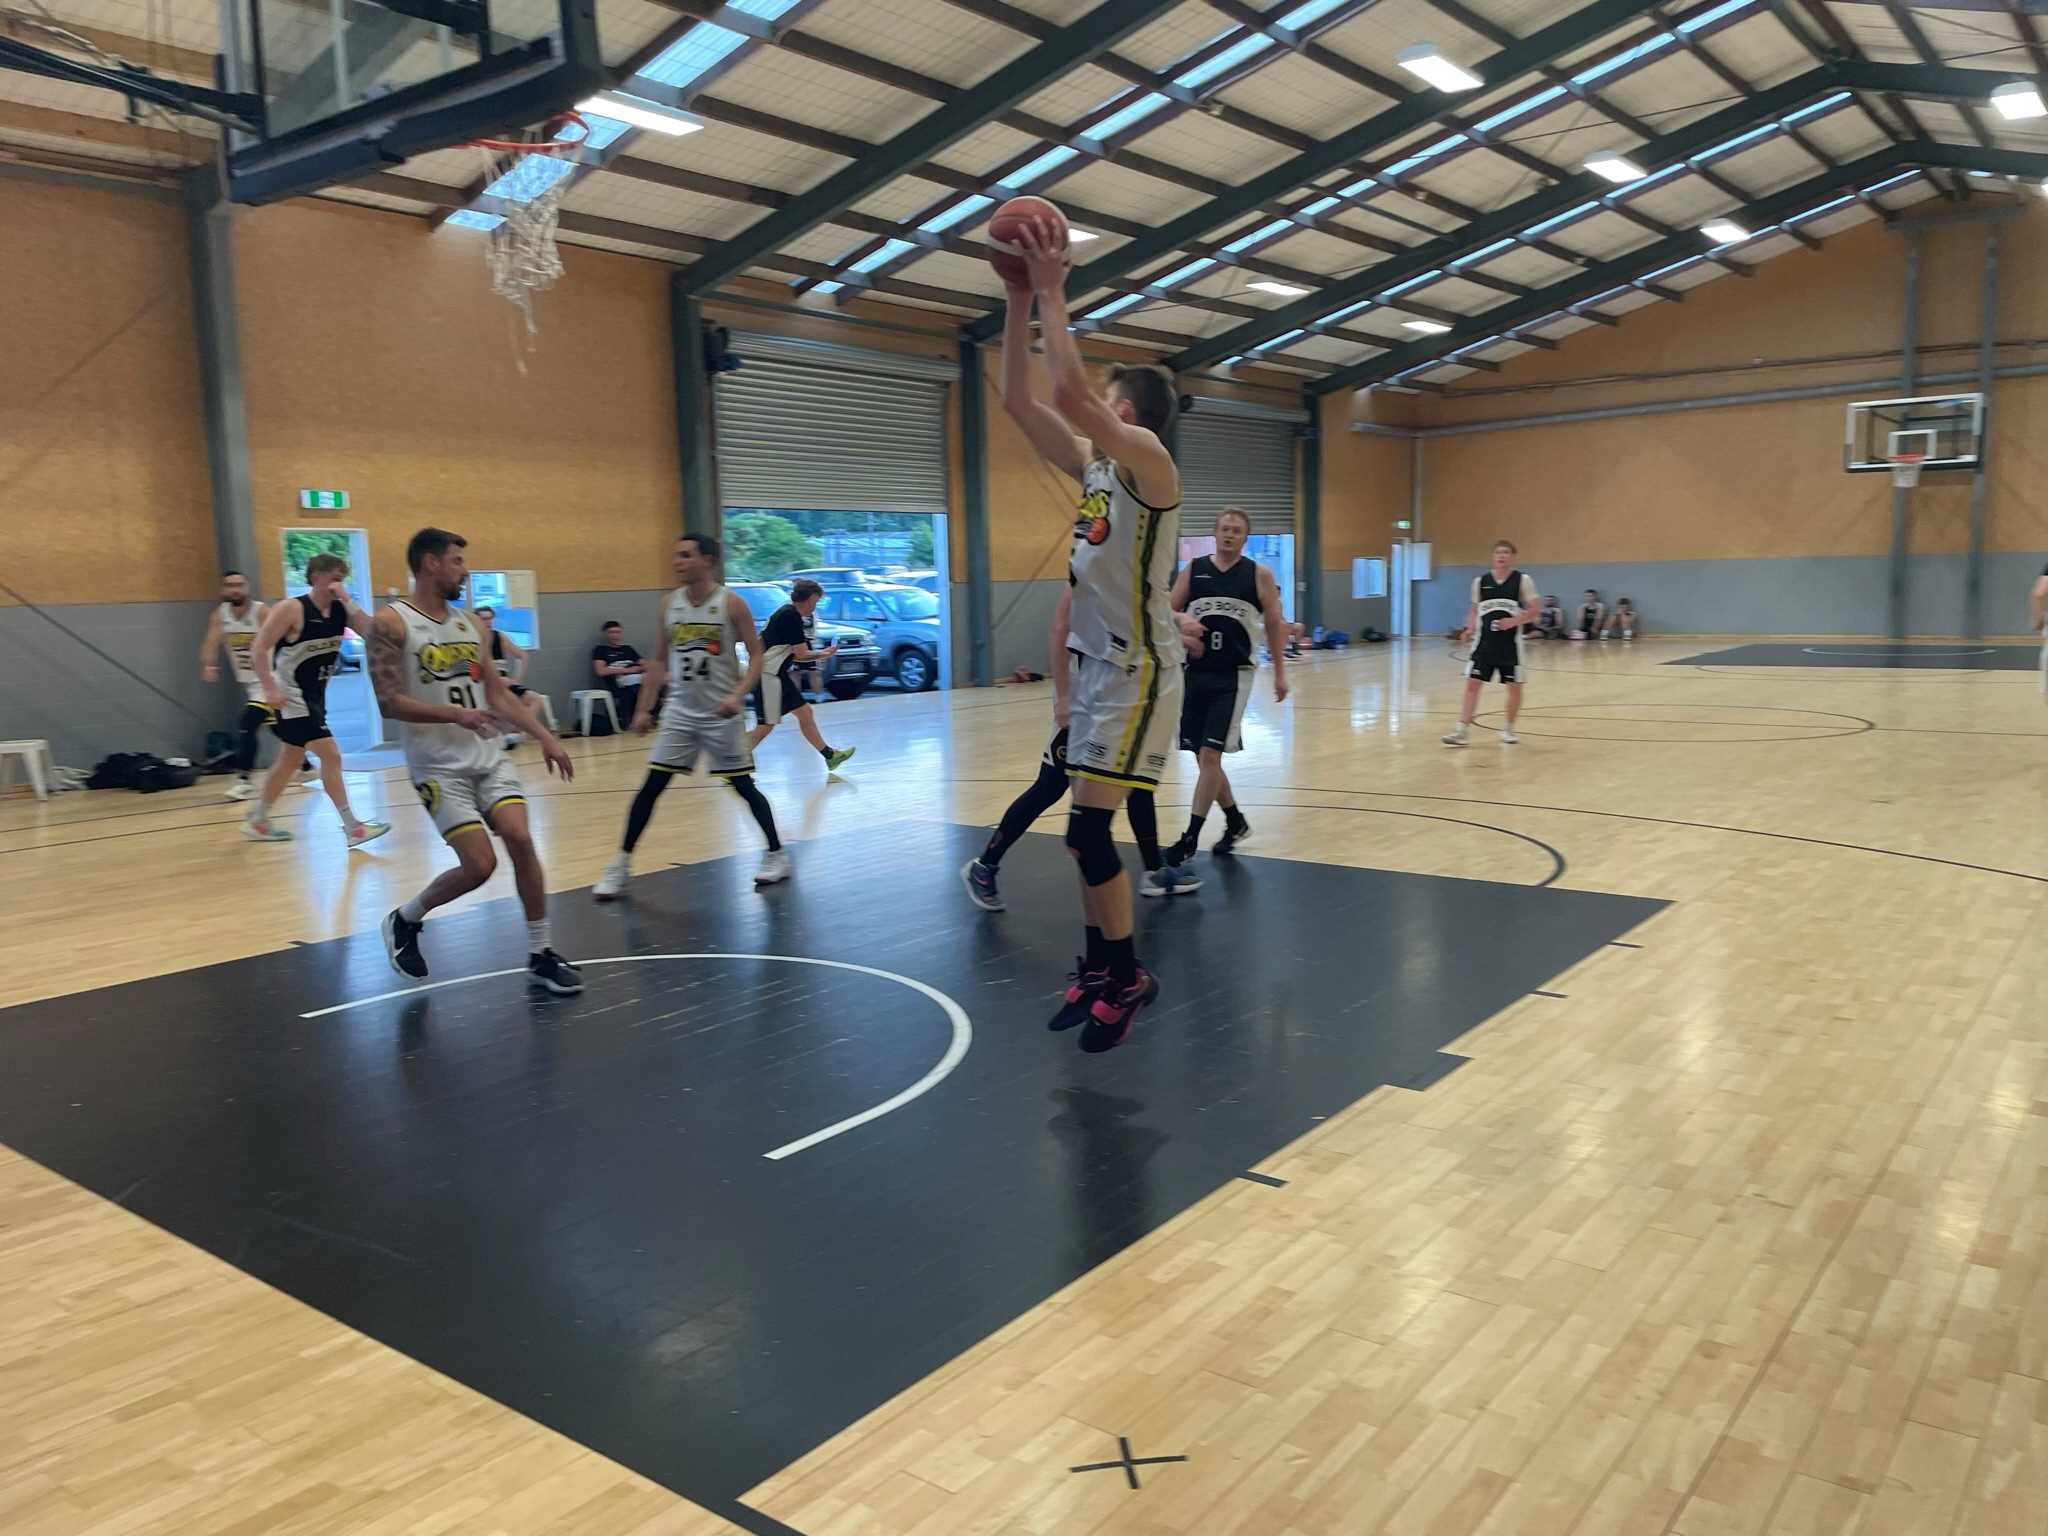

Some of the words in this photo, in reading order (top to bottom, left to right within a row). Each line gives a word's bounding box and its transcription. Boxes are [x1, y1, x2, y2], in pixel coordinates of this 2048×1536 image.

[1214, 601, 1248, 617] BOYS
[1211, 631, 1223, 650] 8
[682, 656, 711, 681] 24
[449, 685, 478, 708] 91
